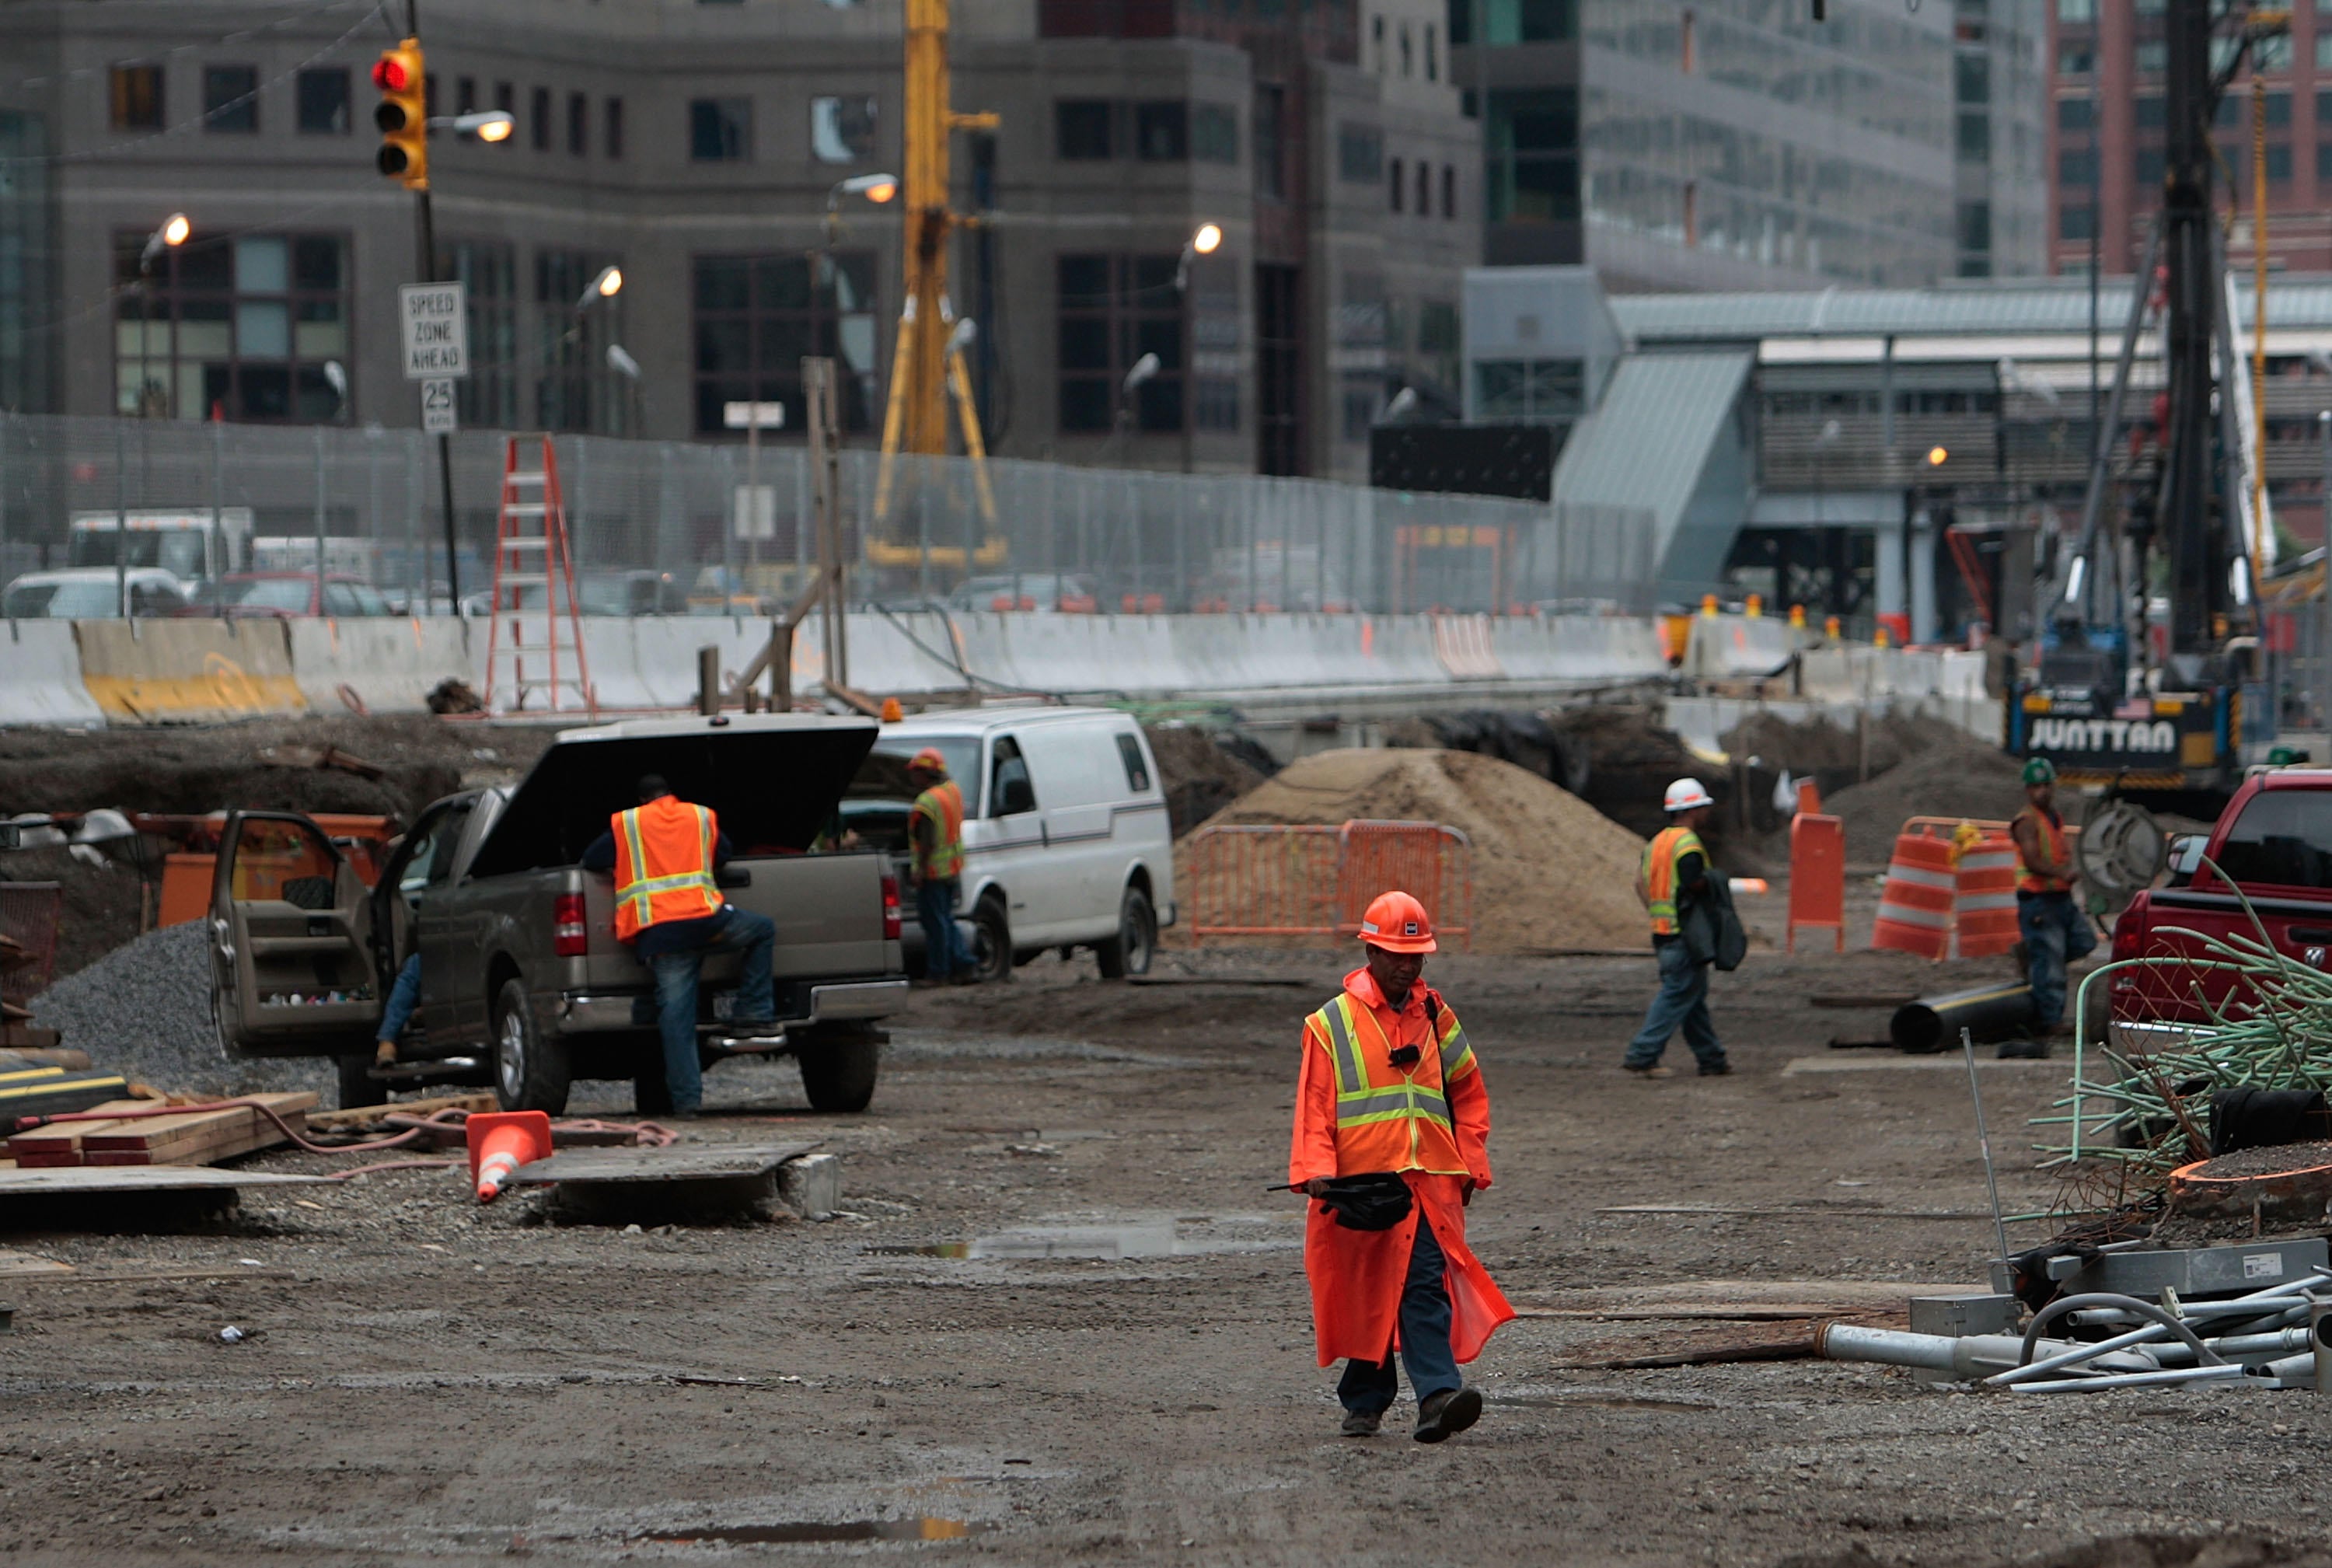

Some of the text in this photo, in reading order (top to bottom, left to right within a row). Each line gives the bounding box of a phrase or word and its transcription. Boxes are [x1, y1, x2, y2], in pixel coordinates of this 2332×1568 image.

[408, 293, 455, 315] SPEED
[414, 322, 452, 342] ZONE
[410, 348, 459, 368] AHEAD
[425, 382, 451, 410] 25
[2028, 719, 2175, 753] JUNTTAN
